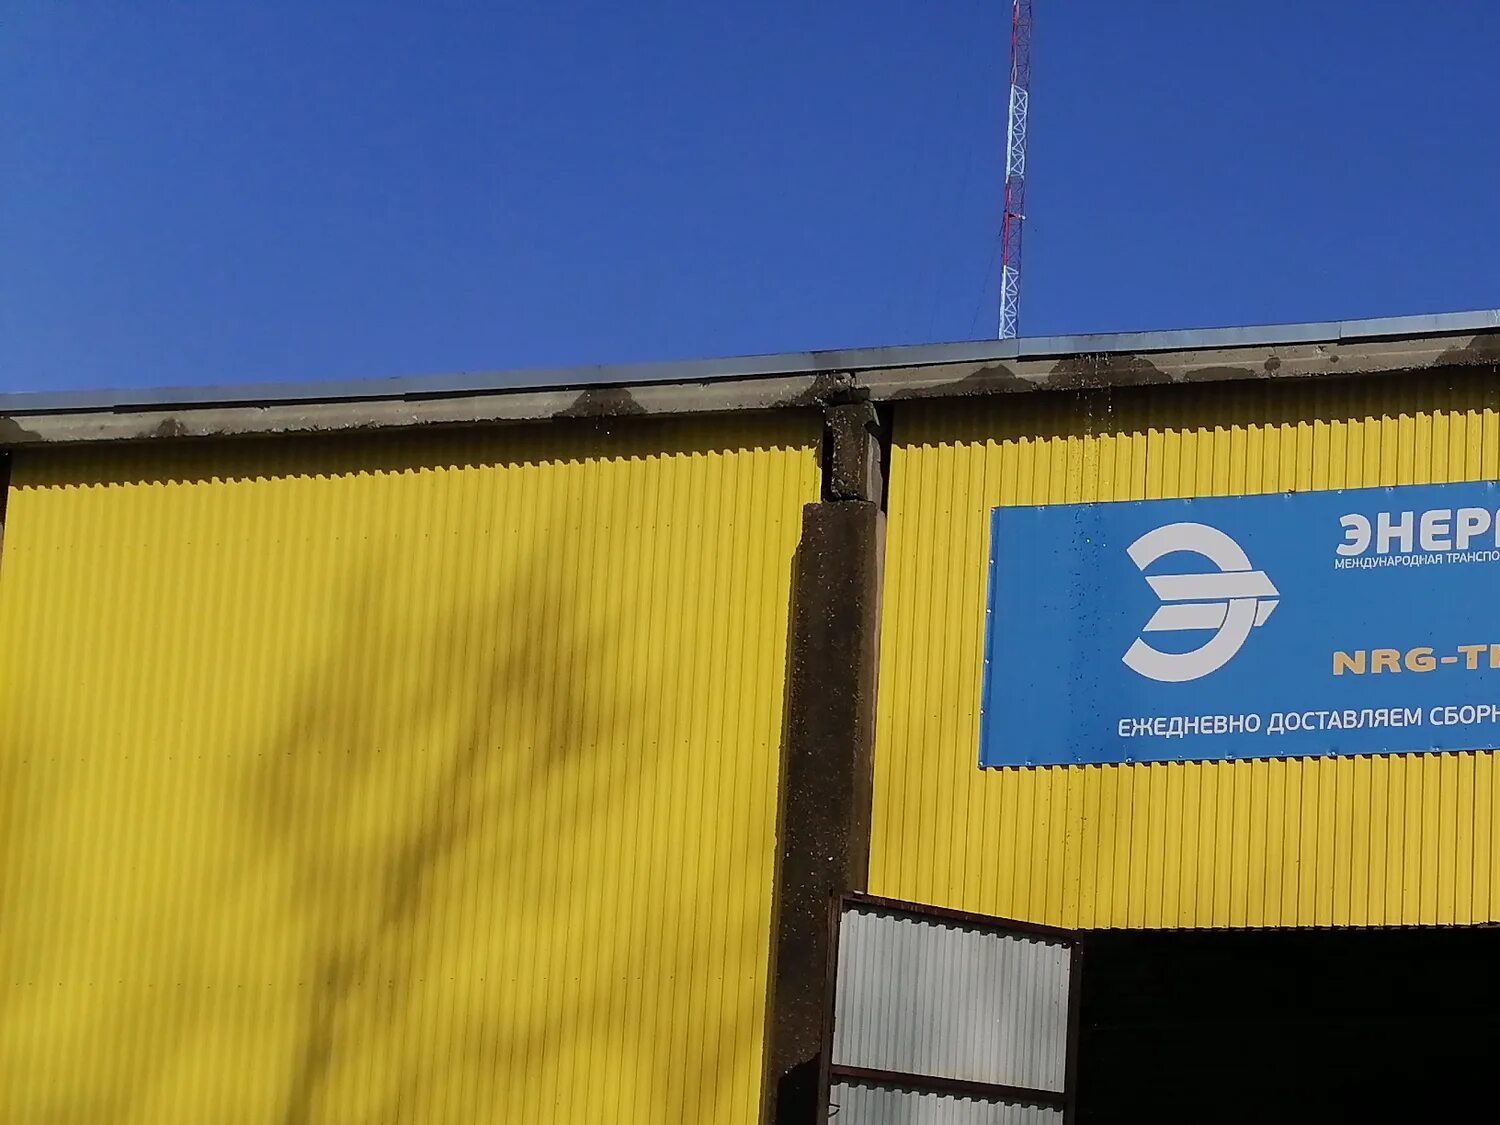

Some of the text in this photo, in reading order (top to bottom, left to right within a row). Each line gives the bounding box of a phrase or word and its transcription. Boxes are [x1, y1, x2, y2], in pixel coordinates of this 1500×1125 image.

[1334, 554, 1443, 570] МЕЖДУНАРОДНАЯ
[1118, 712, 1261, 738] ЕЖЕДНЕВНО
[1266, 706, 1419, 735] ДОСТАВЛЯЕМ
